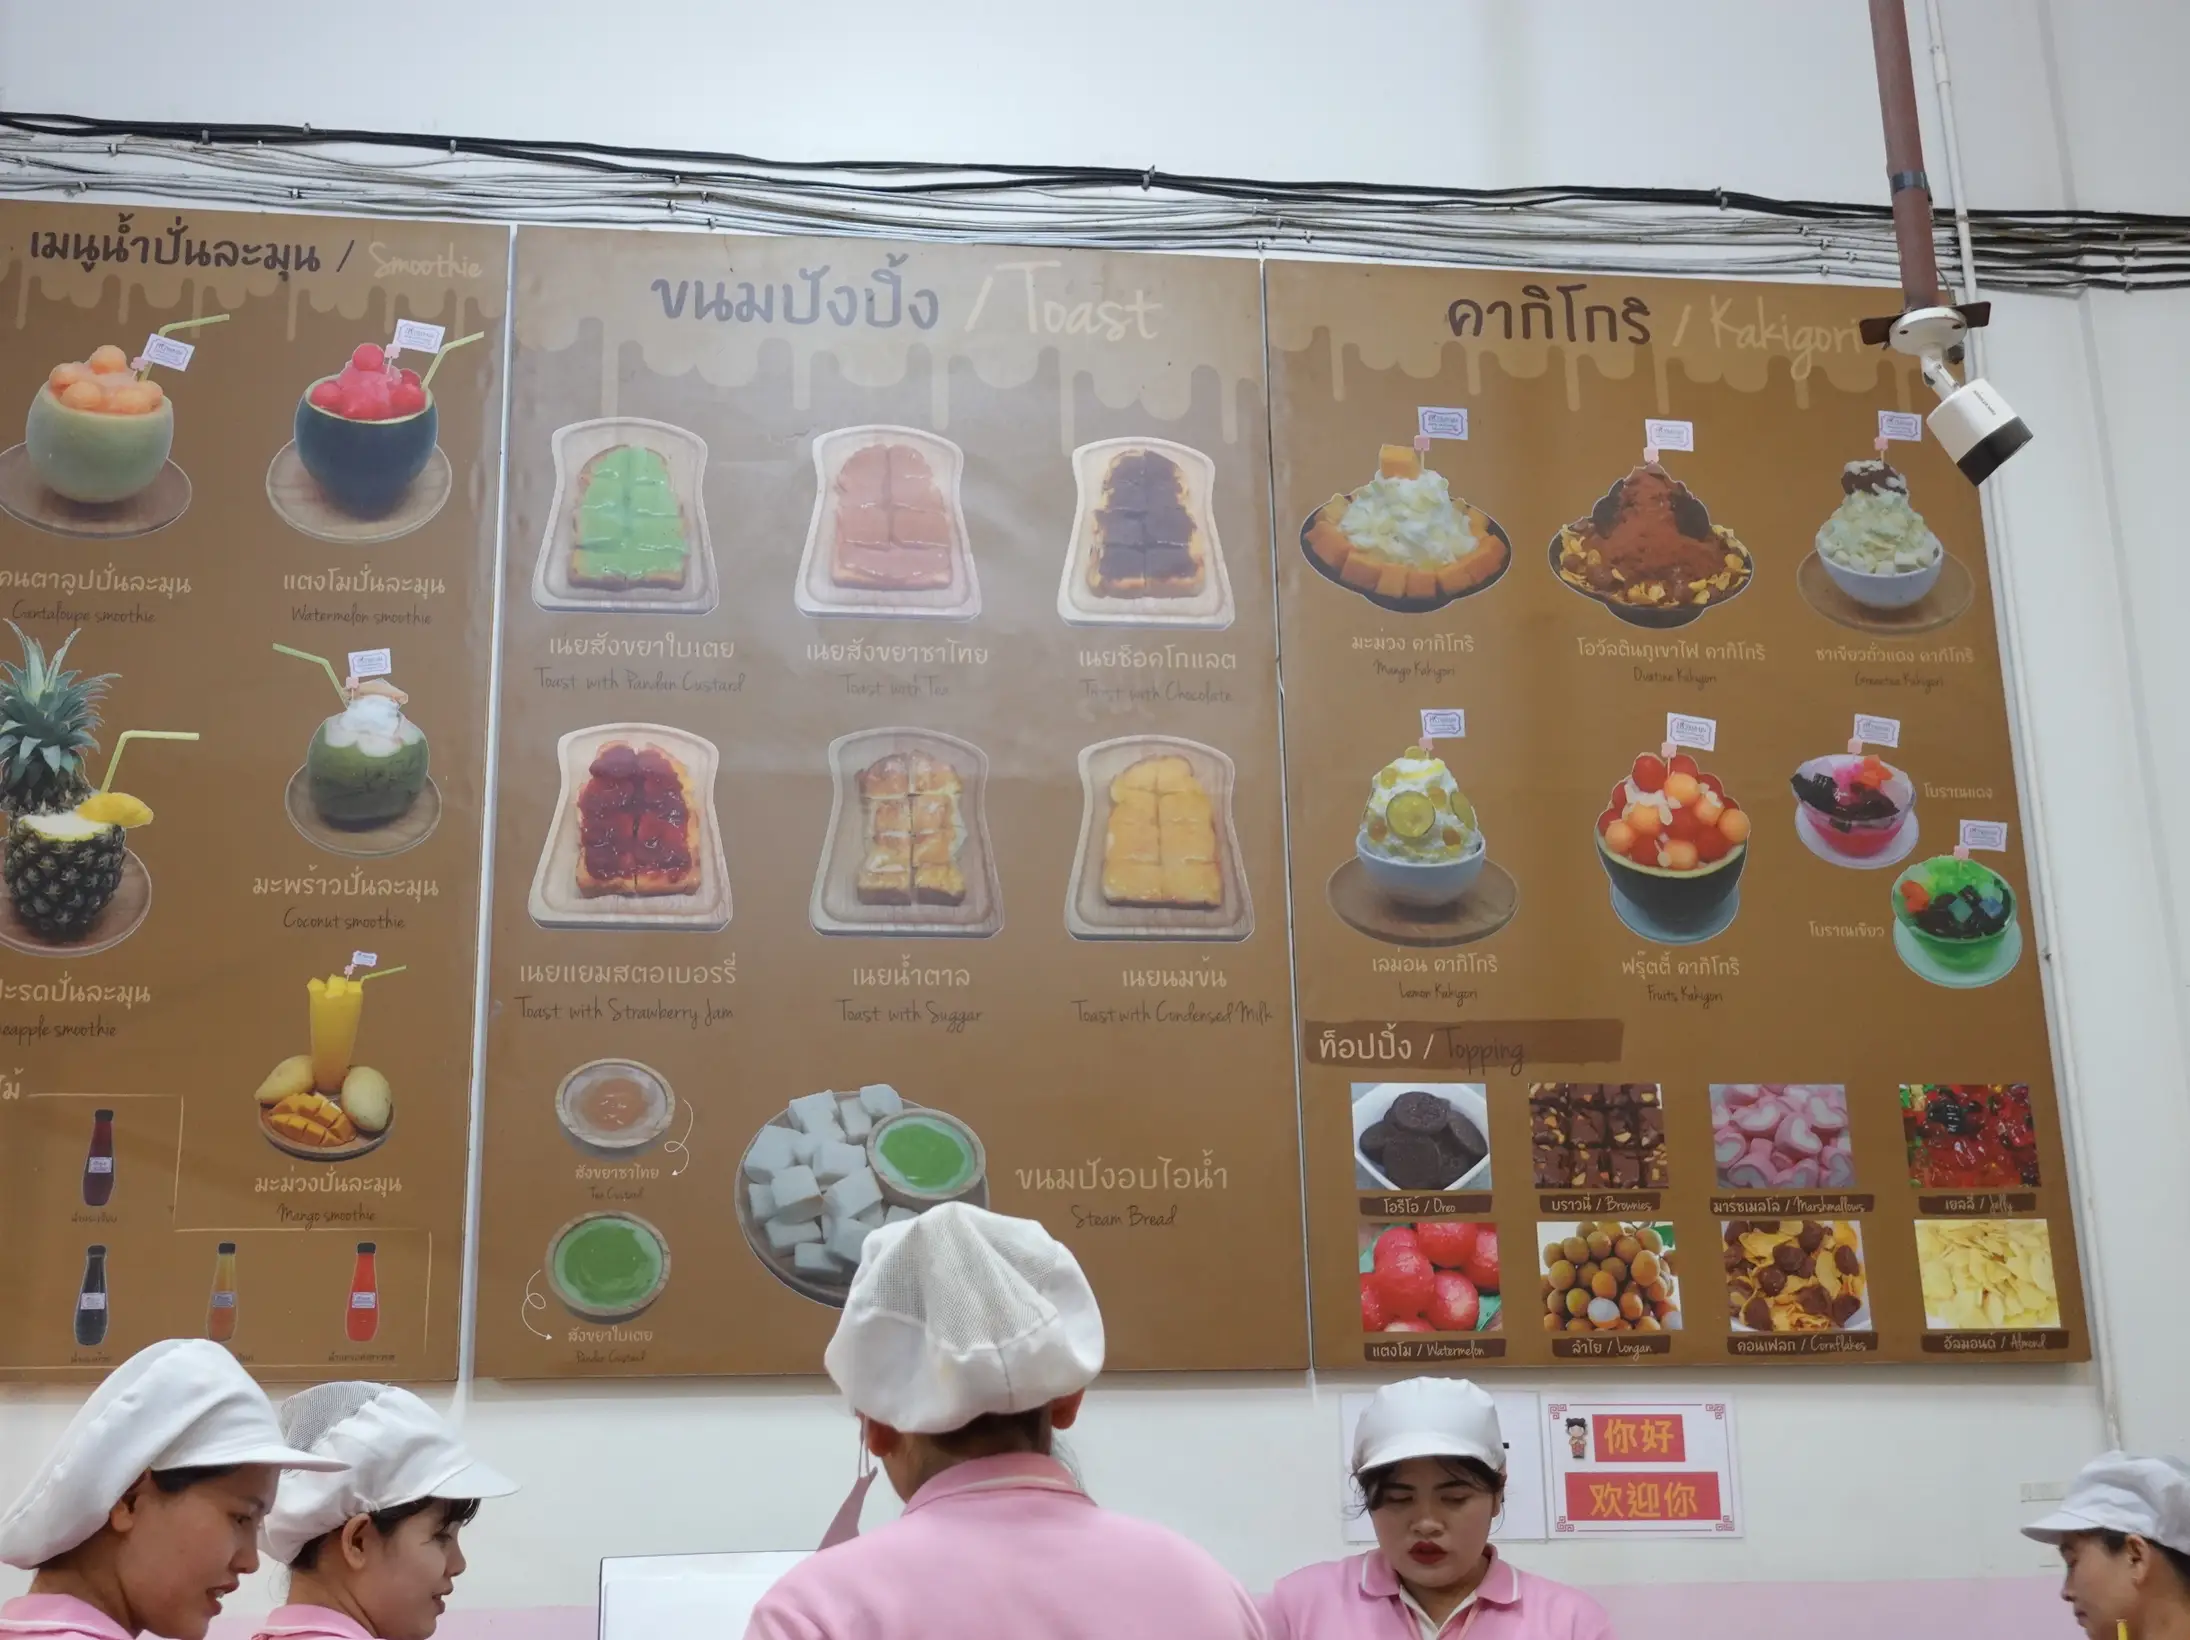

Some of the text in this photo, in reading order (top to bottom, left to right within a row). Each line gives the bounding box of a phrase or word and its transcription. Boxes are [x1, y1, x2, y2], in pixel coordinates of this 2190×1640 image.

[30, 212, 321, 282] เมนูน้ำปั่นละมุน
[368, 241, 483, 279] Smoothie
[651, 253, 939, 332] ขนมปังปิ้ง
[995, 260, 1163, 342] Toast
[1448, 284, 1651, 346] คากิโกริ
[1709, 294, 1861, 381] Kakigori
[283, 563, 446, 600] แตงโมปั่นละมุน
[95, 603, 157, 624] smoothie
[291, 602, 432, 627] Watermelon smoothie
[1351, 627, 1475, 653] มะม่วง คากิโกริ
[534, 667, 577, 689] Toast
[586, 668, 619, 690] with
[252, 864, 440, 903] มะพร้าวปั่นละมุน
[283, 907, 405, 930] Coconut smoothie
[852, 953, 971, 987] เนยน้ำตาล
[1123, 955, 1227, 988] เนยนมข้น
[1372, 947, 1499, 974] เลม่อน คากิโกริ
[514, 995, 734, 1030] Toast with Strawberry Jam
[834, 998, 882, 1022] Toast
[888, 999, 921, 1022] with
[1070, 999, 1116, 1024] Toast
[1119, 1000, 1151, 1023] with
[0, 1013, 117, 1046] eapple smoothie
[1319, 1022, 1412, 1060] ท็อปปิ้ง
[1434, 1026, 1524, 1076] Topping
[254, 1165, 403, 1198] มะม่วงปั่นละมุน
[1015, 1146, 1228, 1190] ขนมปังอบไอน้ำ
[276, 1202, 377, 1231] Mango smoothie
[1071, 1204, 1178, 1229] Steam Bread
[1372, 1340, 1412, 1357] แตงโม
[1426, 1339, 1485, 1360] Watermelon
[1616, 1335, 1653, 1361] Longan
[1603, 1418, 1675, 1455] 你好
[1588, 1481, 1699, 1519] 欢迎你
